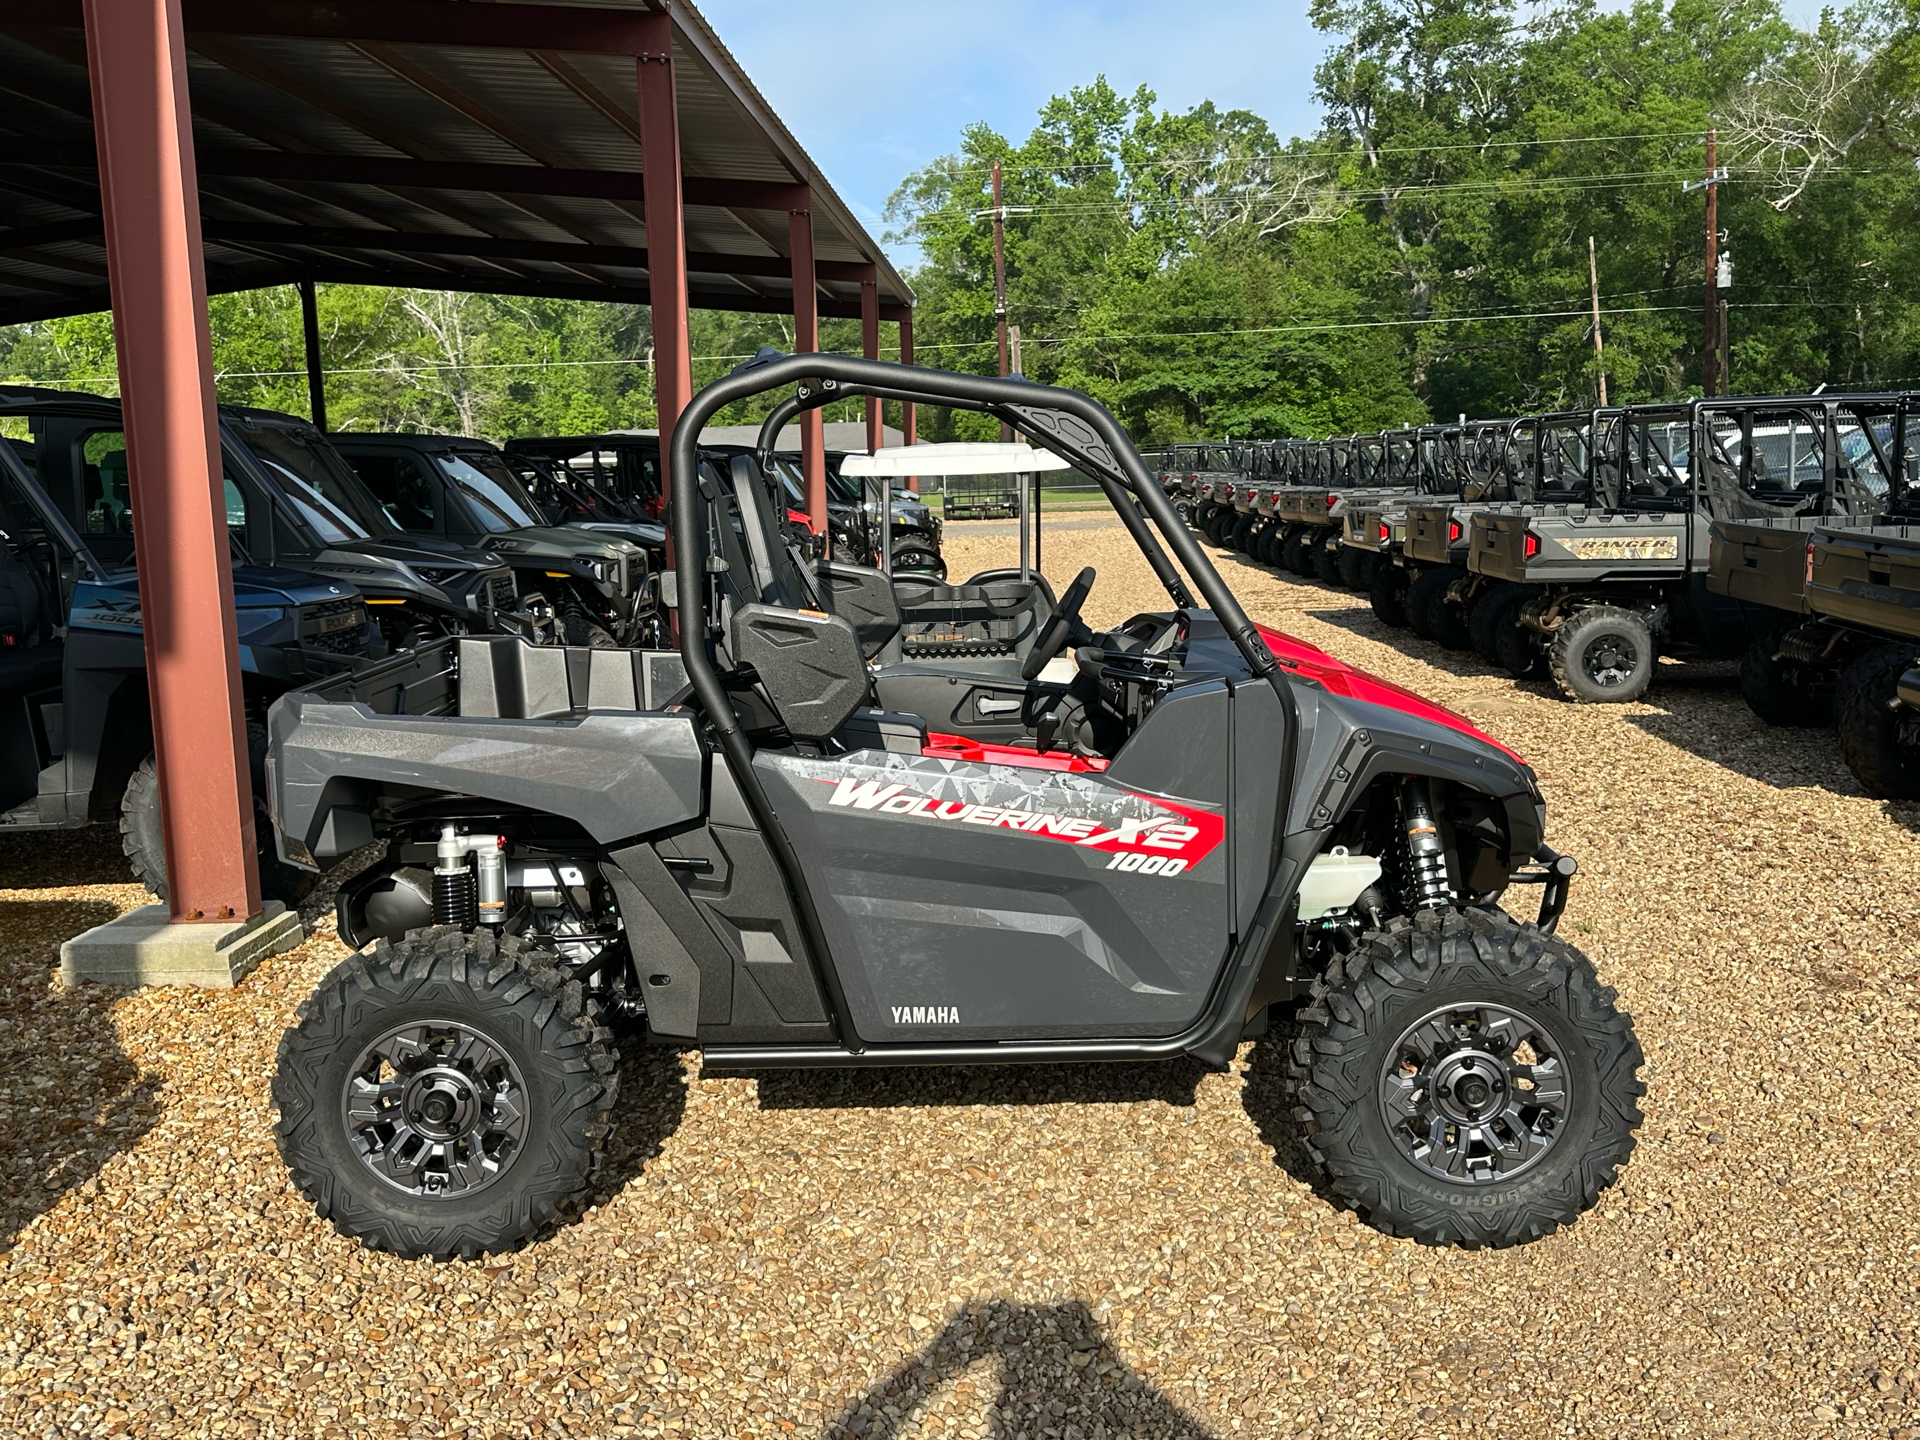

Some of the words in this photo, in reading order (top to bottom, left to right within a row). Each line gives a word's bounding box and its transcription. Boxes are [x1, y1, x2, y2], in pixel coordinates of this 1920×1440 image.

[490, 541, 518, 549] XP
[1581, 540, 1668, 548] RANGER
[310, 567, 376, 575] 1500
[1858, 586, 1900, 604] POLARIS
[828, 777, 1102, 838] WOLVERINE
[1075, 815, 1199, 850] X2
[1105, 851, 1188, 877] 1000
[891, 1006, 960, 1024] YAMAHA
[1416, 1182, 1521, 1207] BIGHORN
